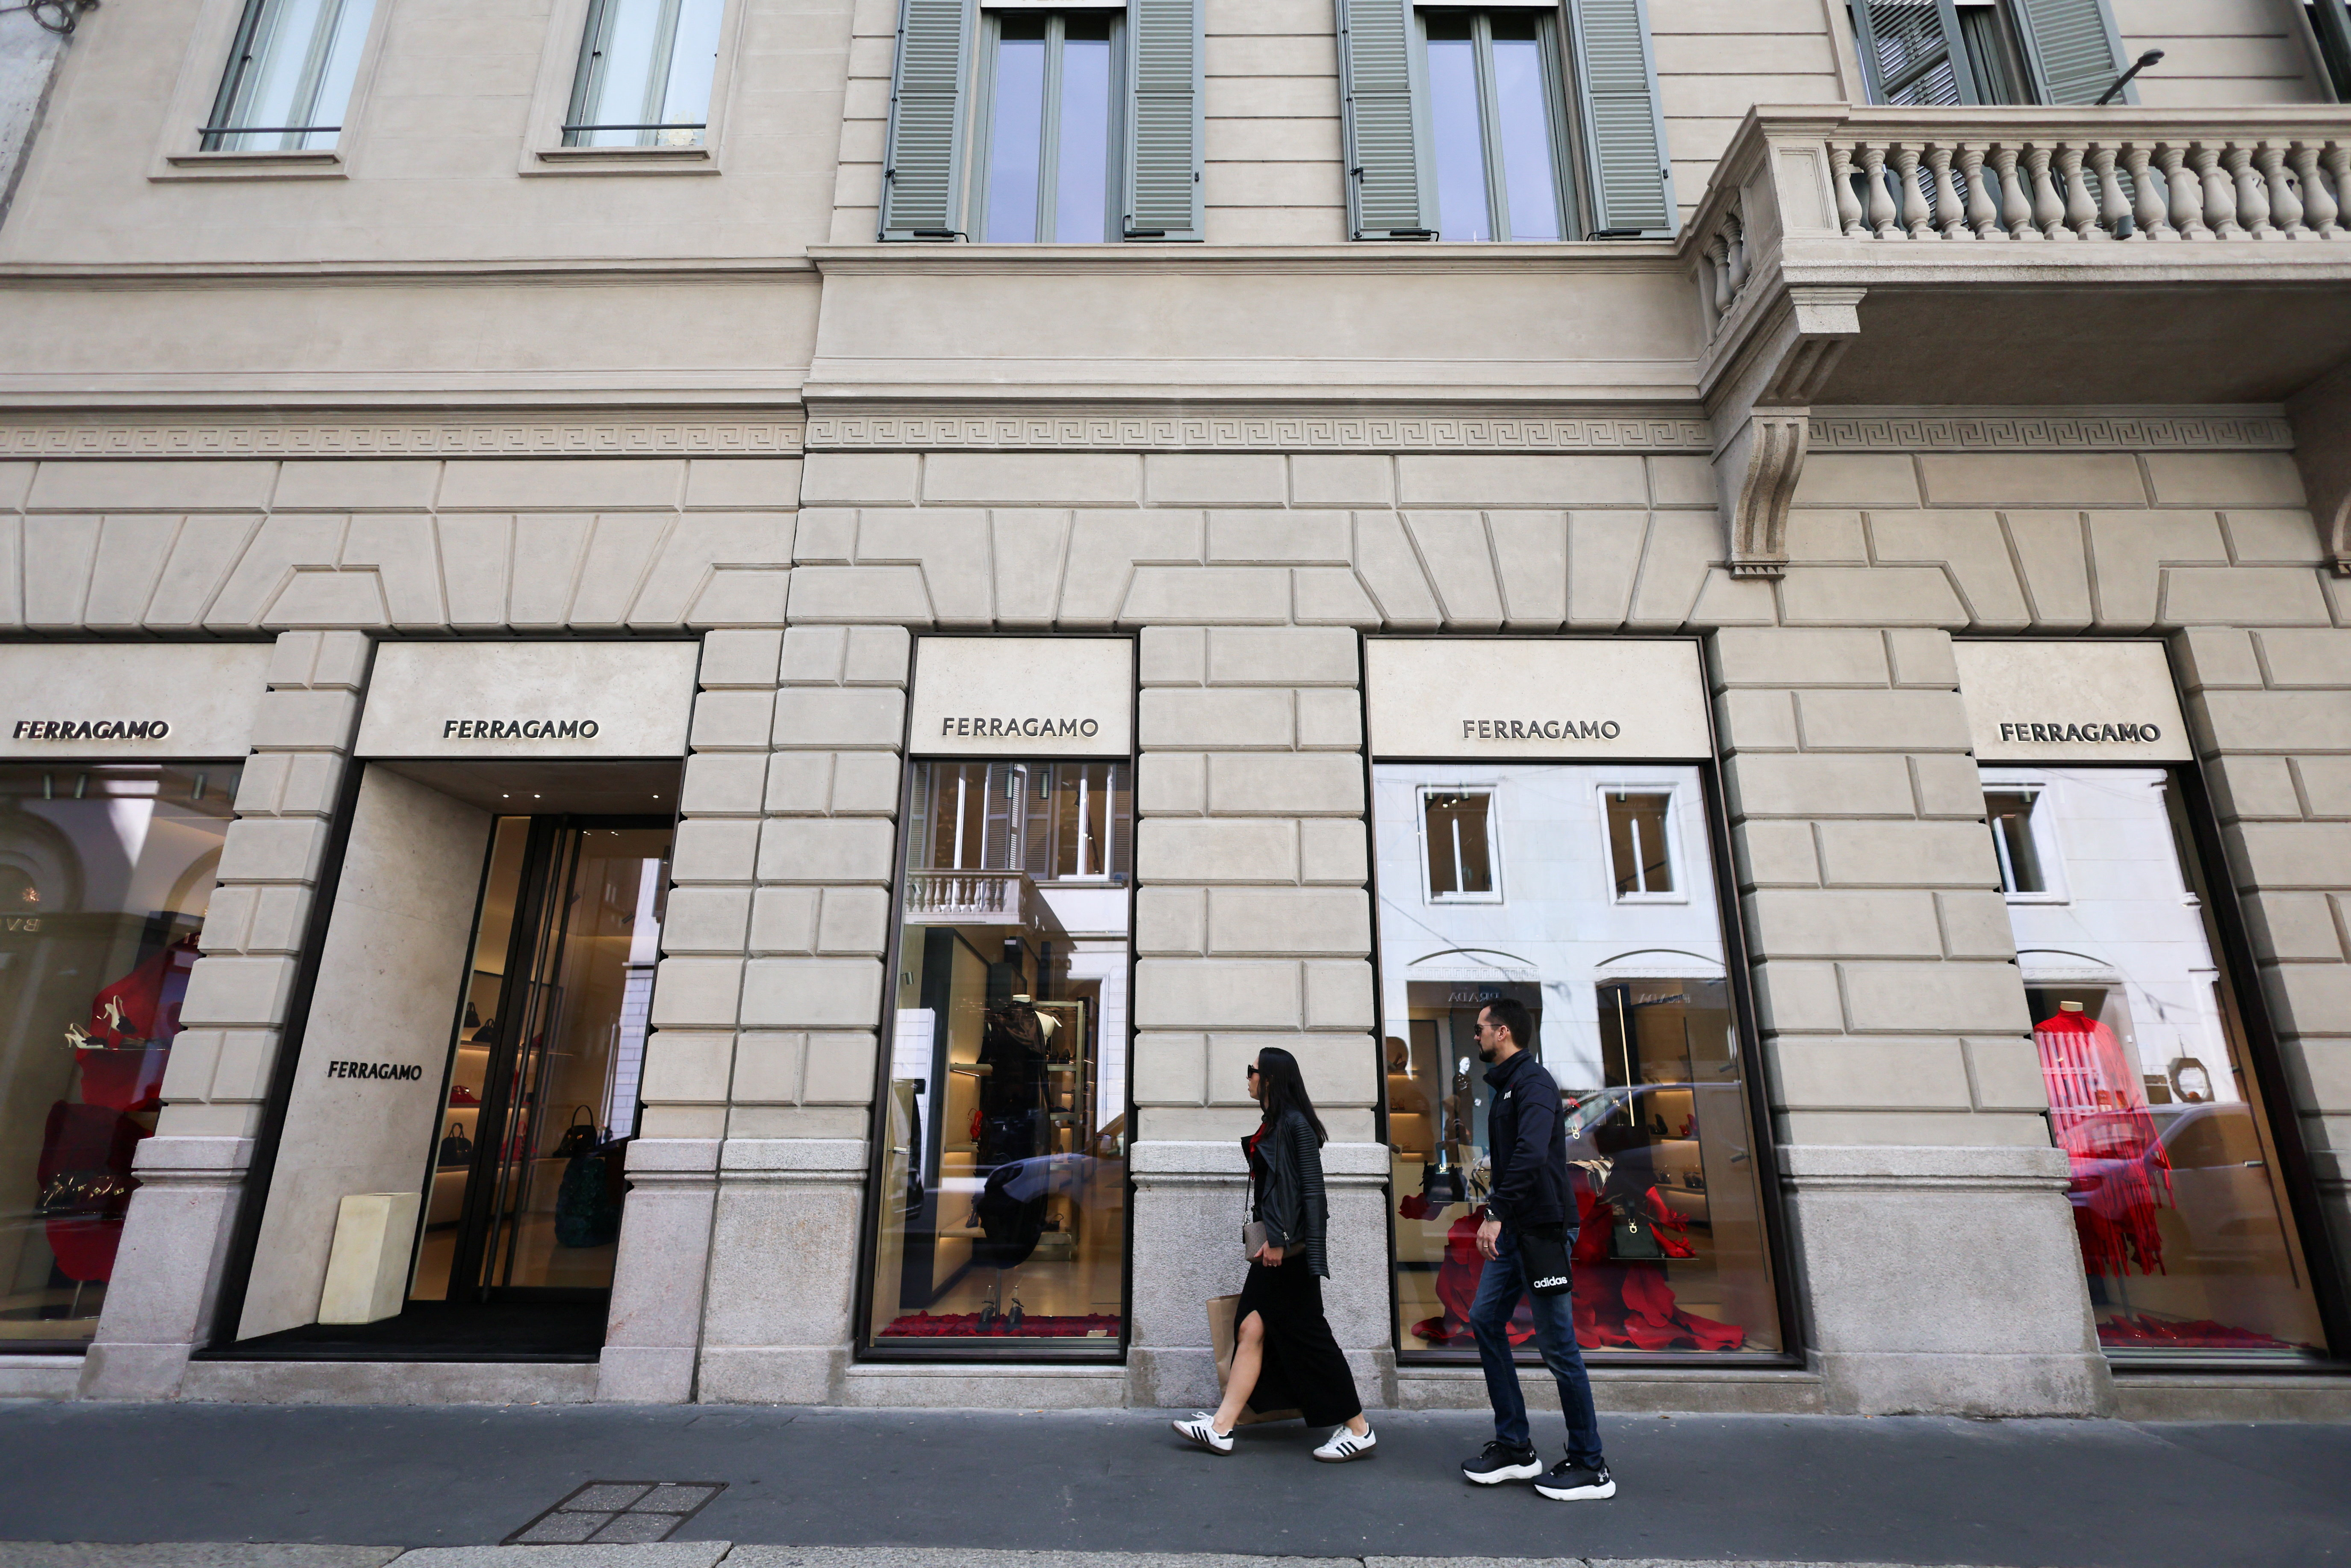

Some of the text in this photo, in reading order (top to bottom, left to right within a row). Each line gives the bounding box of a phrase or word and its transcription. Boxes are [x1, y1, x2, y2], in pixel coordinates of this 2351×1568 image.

[12, 721, 169, 740] FERRAGAMO
[443, 720, 599, 739] FERRAGAMO
[942, 718, 1098, 737] FERRAGAMO
[1463, 720, 1620, 739] FERRAGAMO
[2000, 723, 2161, 742] FERRAGAMO
[327, 1061, 422, 1081] FERRAGAMO
[1534, 1276, 1568, 1288] adidas
